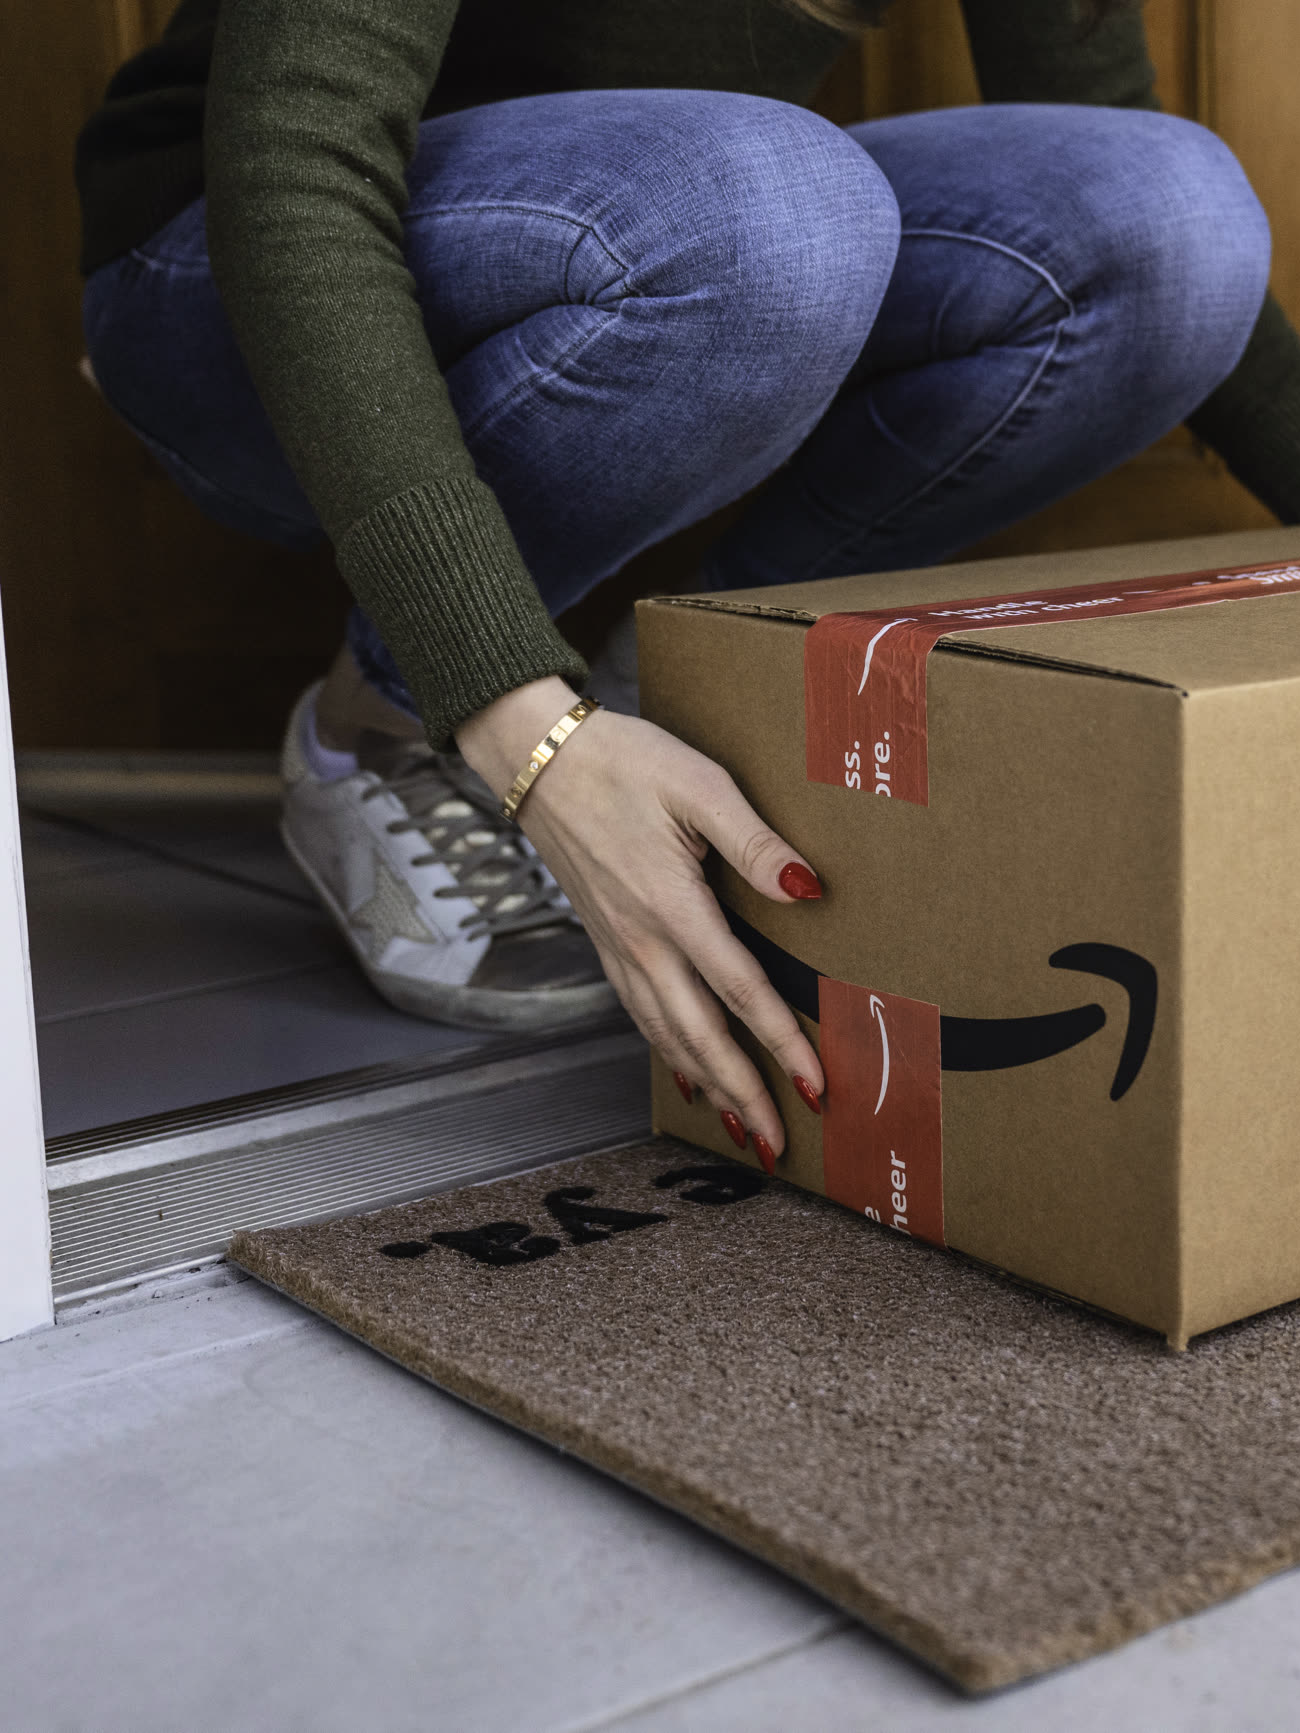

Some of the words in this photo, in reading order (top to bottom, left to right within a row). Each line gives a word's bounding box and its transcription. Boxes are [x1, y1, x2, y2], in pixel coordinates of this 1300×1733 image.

[928, 600, 1048, 617] Handle
[962, 608, 1039, 620] with
[1041, 596, 1125, 612] cheer
